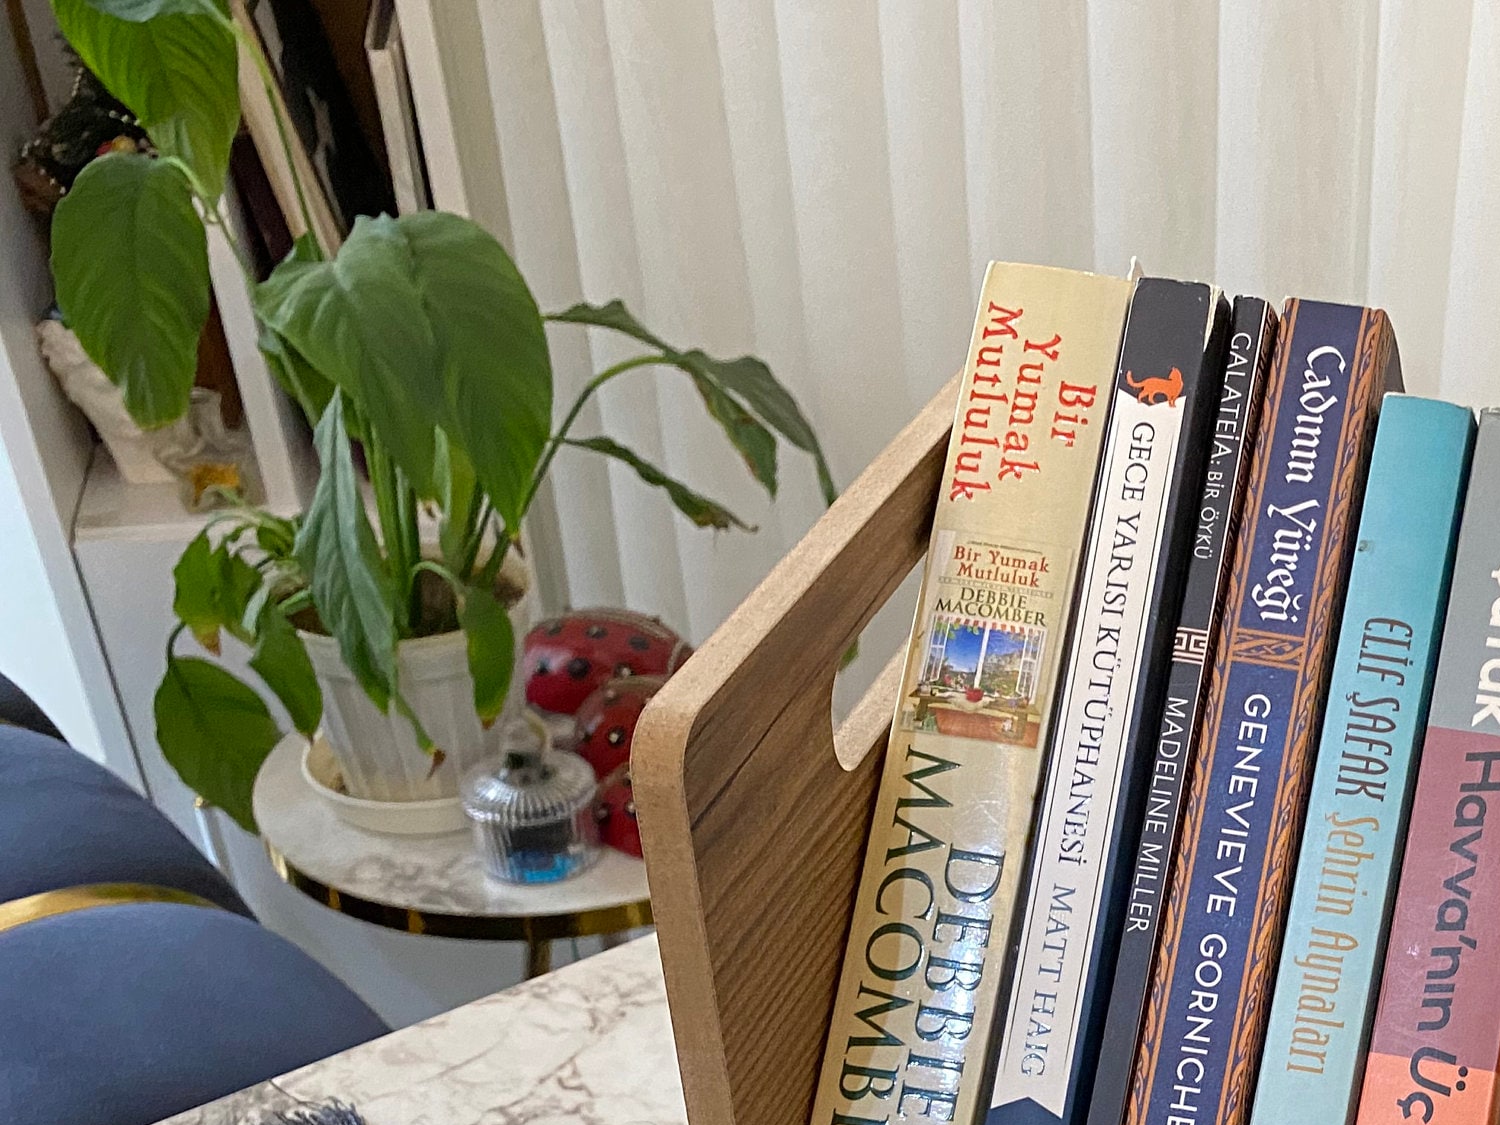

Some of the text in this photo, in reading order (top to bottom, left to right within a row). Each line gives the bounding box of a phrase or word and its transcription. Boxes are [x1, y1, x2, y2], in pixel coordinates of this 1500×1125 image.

[949, 300, 1024, 503] Mutluluk
[998, 333, 1062, 482] Yumak
[1051, 381, 1097, 448] Bir
[1193, 331, 1252, 561] GALATEİA: BİR ÖYKÜ
[1251, 344, 1345, 624] Cadının Yüreği
[935, 598, 1047, 627] MACOMBER
[953, 545, 981, 562] Bir
[988, 549, 1049, 573] Yumak
[956, 562, 1039, 588] Mutluluk
[960, 586, 1028, 609] DEBBIE
[1020, 421, 1156, 1078] GECE YARISI KÜTÜPHANESİ MATT HAIG
[1126, 695, 1189, 933] MADELINE MILLER
[1206, 694, 1271, 917] GENEVIEVE
[1334, 690, 1399, 802] ŞAFAK
[897, 842, 1006, 1122] DEBBIE
[1286, 811, 1379, 1075] Şehrin Aynaları
[1397, 1047, 1469, 1124] Üç
